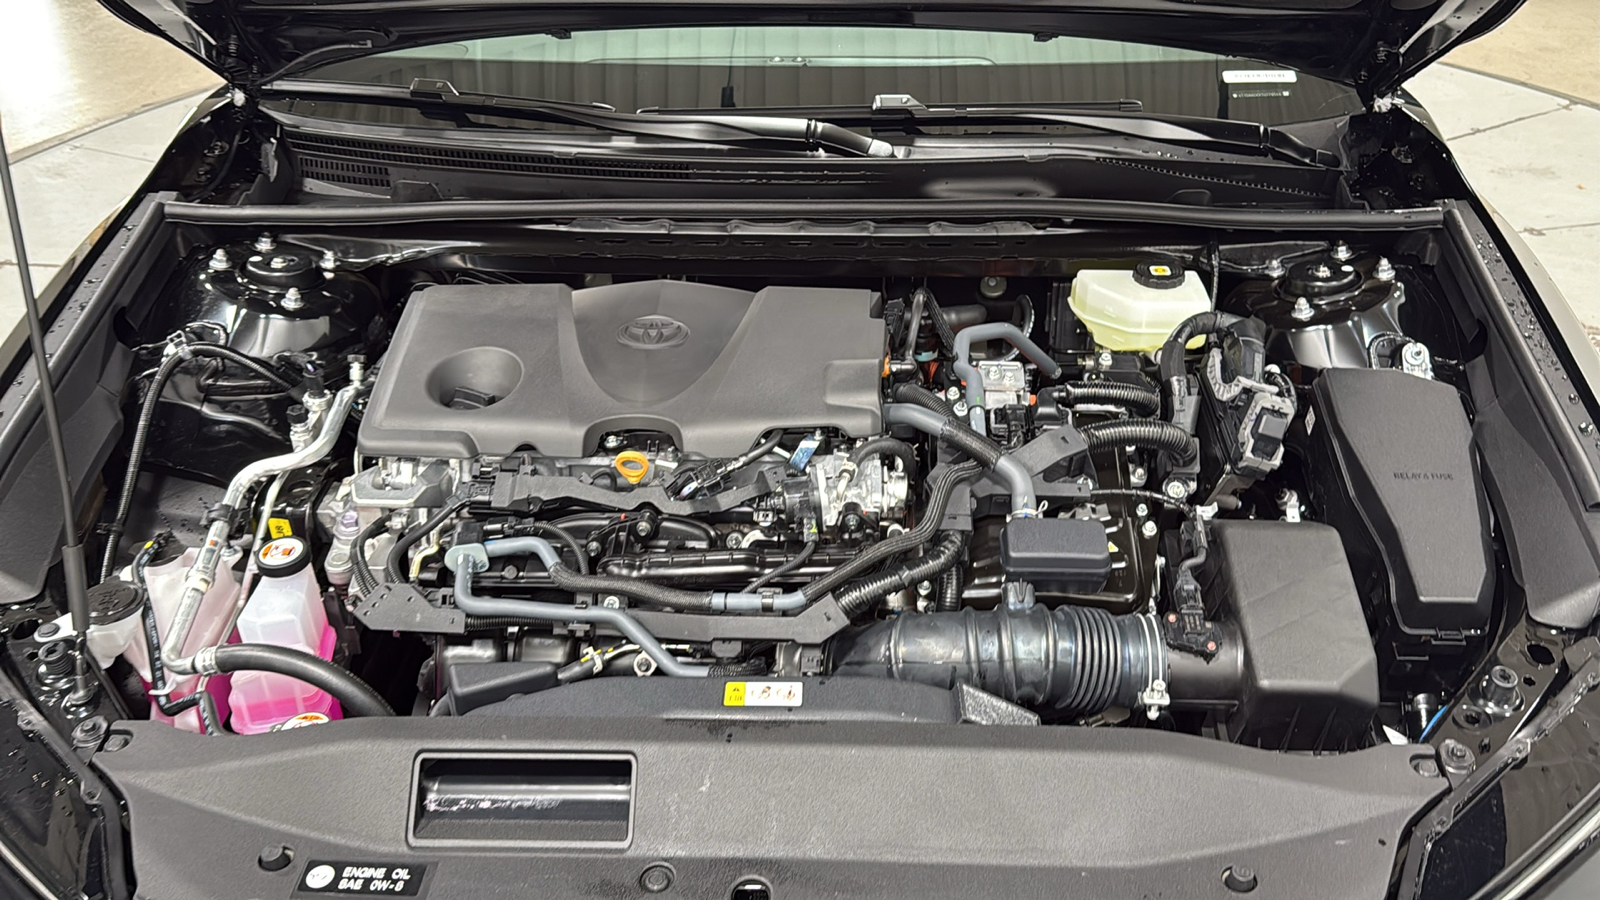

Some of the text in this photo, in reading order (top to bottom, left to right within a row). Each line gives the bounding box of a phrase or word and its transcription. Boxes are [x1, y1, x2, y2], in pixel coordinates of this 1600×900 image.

[342, 867, 411, 880] ENGINE OIL
[338, 878, 364, 890] SAE
